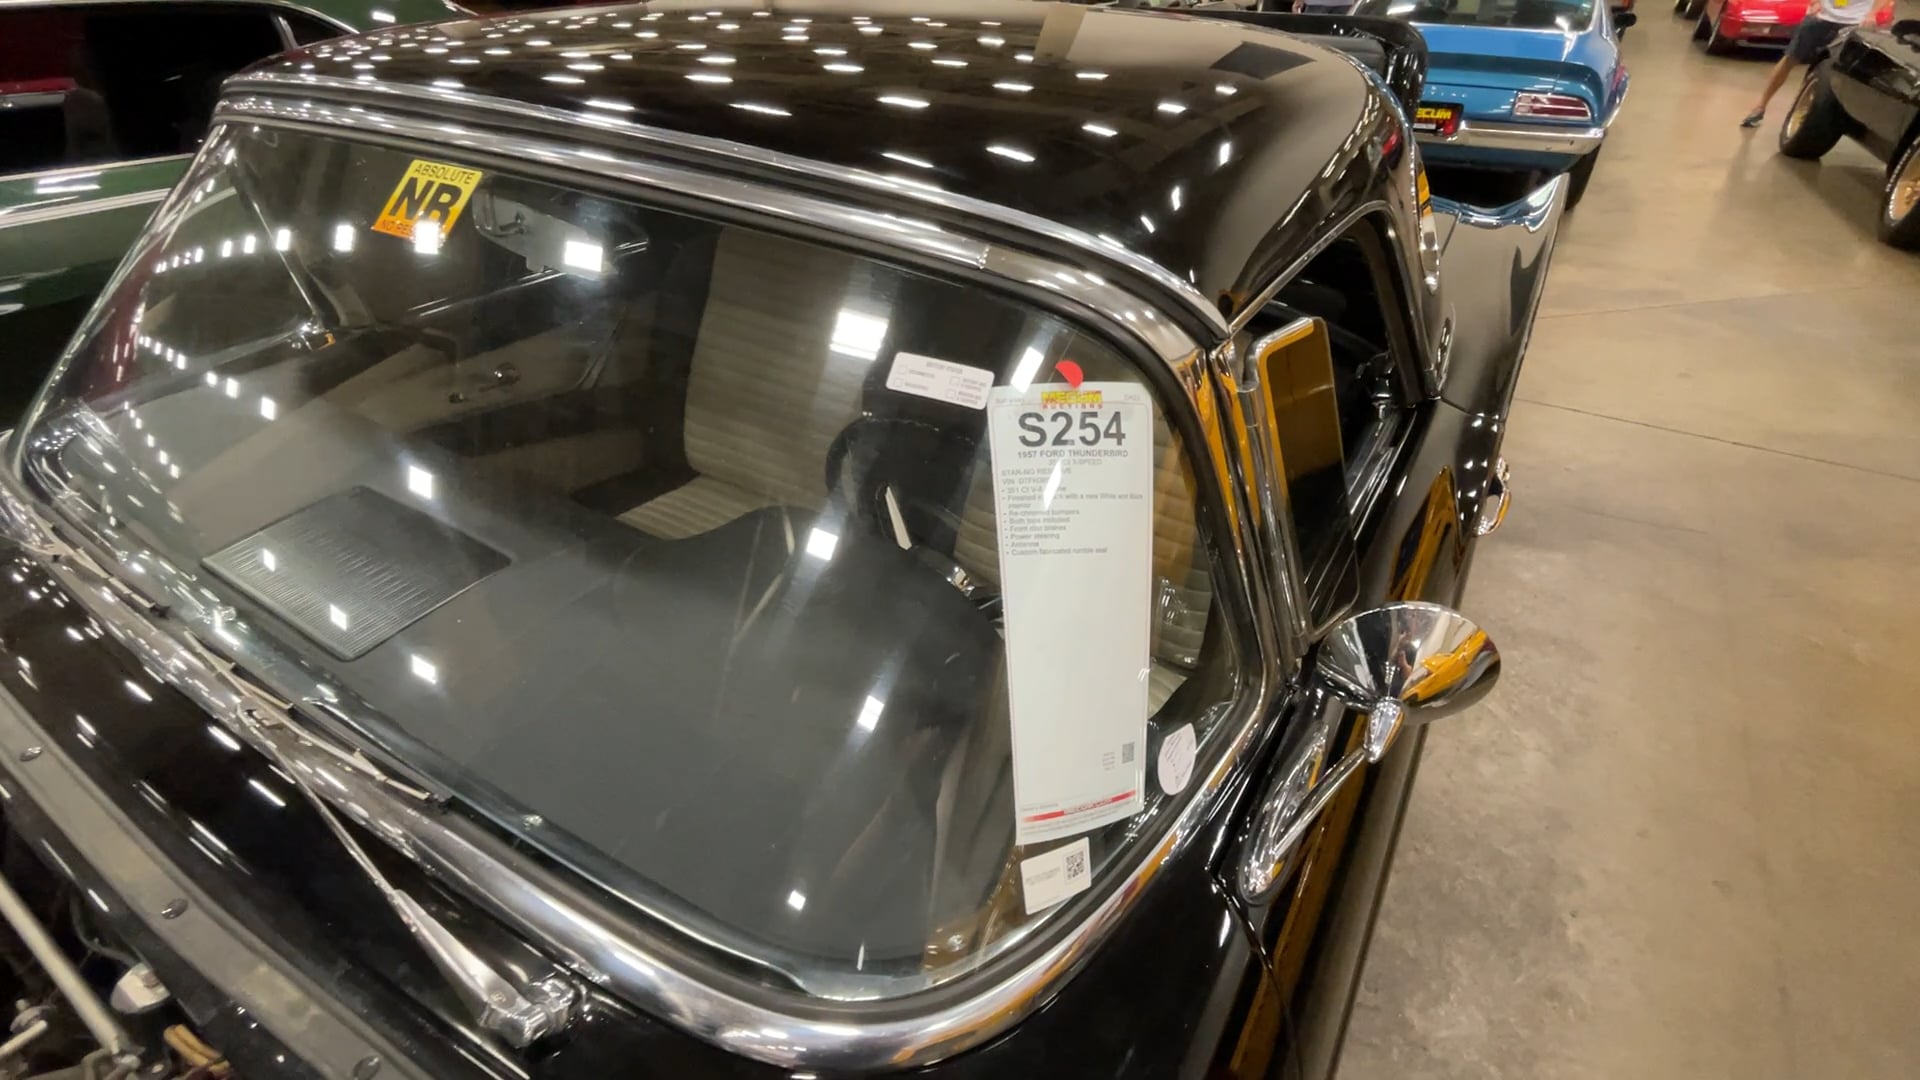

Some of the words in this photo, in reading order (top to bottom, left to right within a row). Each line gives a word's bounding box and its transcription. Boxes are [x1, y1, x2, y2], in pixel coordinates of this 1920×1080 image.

[1416, 107, 1452, 120] ECUM
[413, 163, 476, 185] ABSOLUTE
[388, 175, 464, 229] NR
[1018, 411, 1126, 448] S254
[1017, 450, 1038, 459] 1957
[1039, 449, 1065, 458] FORD
[1068, 448, 1129, 458] THUNDERBIRD
